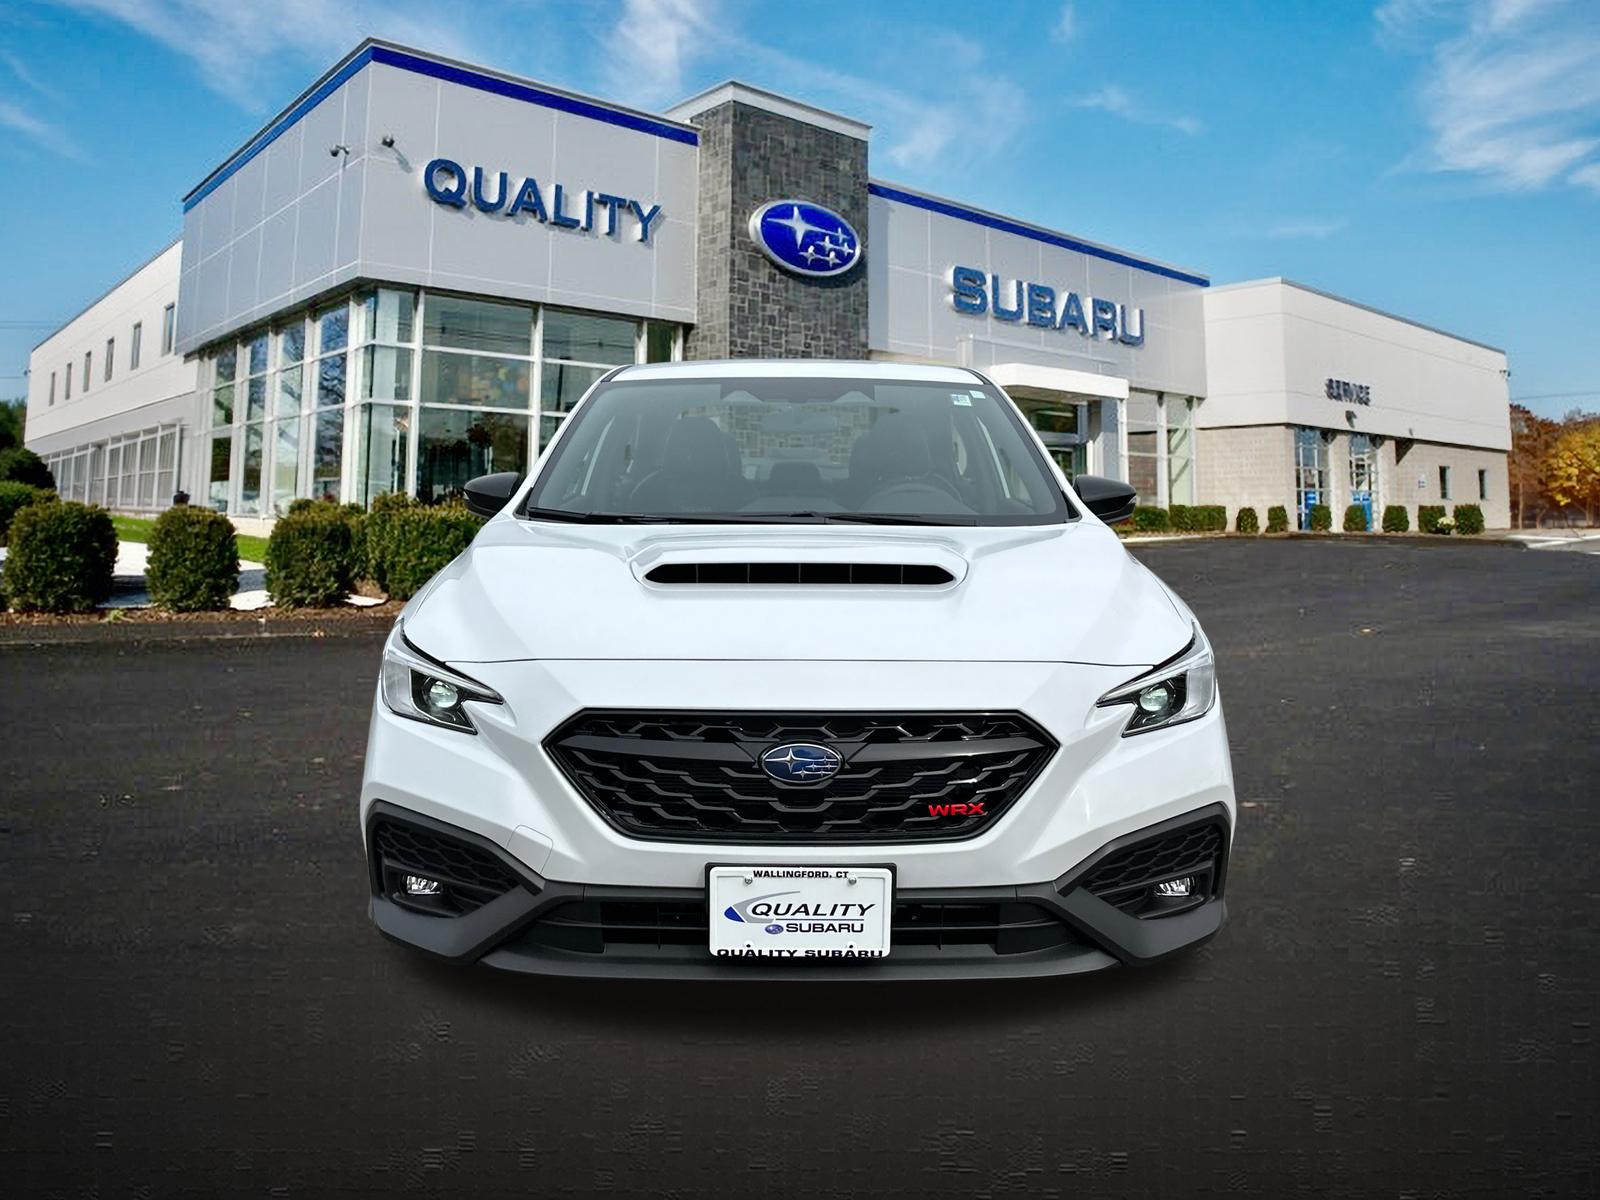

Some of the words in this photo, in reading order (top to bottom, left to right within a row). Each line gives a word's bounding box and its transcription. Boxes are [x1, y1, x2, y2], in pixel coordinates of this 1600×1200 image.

[424, 158, 662, 243] QUALITY
[951, 265, 1145, 347] SUBARU
[928, 802, 985, 817] WRX
[835, 871, 849, 879] CT
[751, 903, 876, 917] QUALITY
[785, 923, 864, 933] SUBARU
[716, 949, 798, 958] QUALITY
[804, 949, 883, 958] SUBARU
